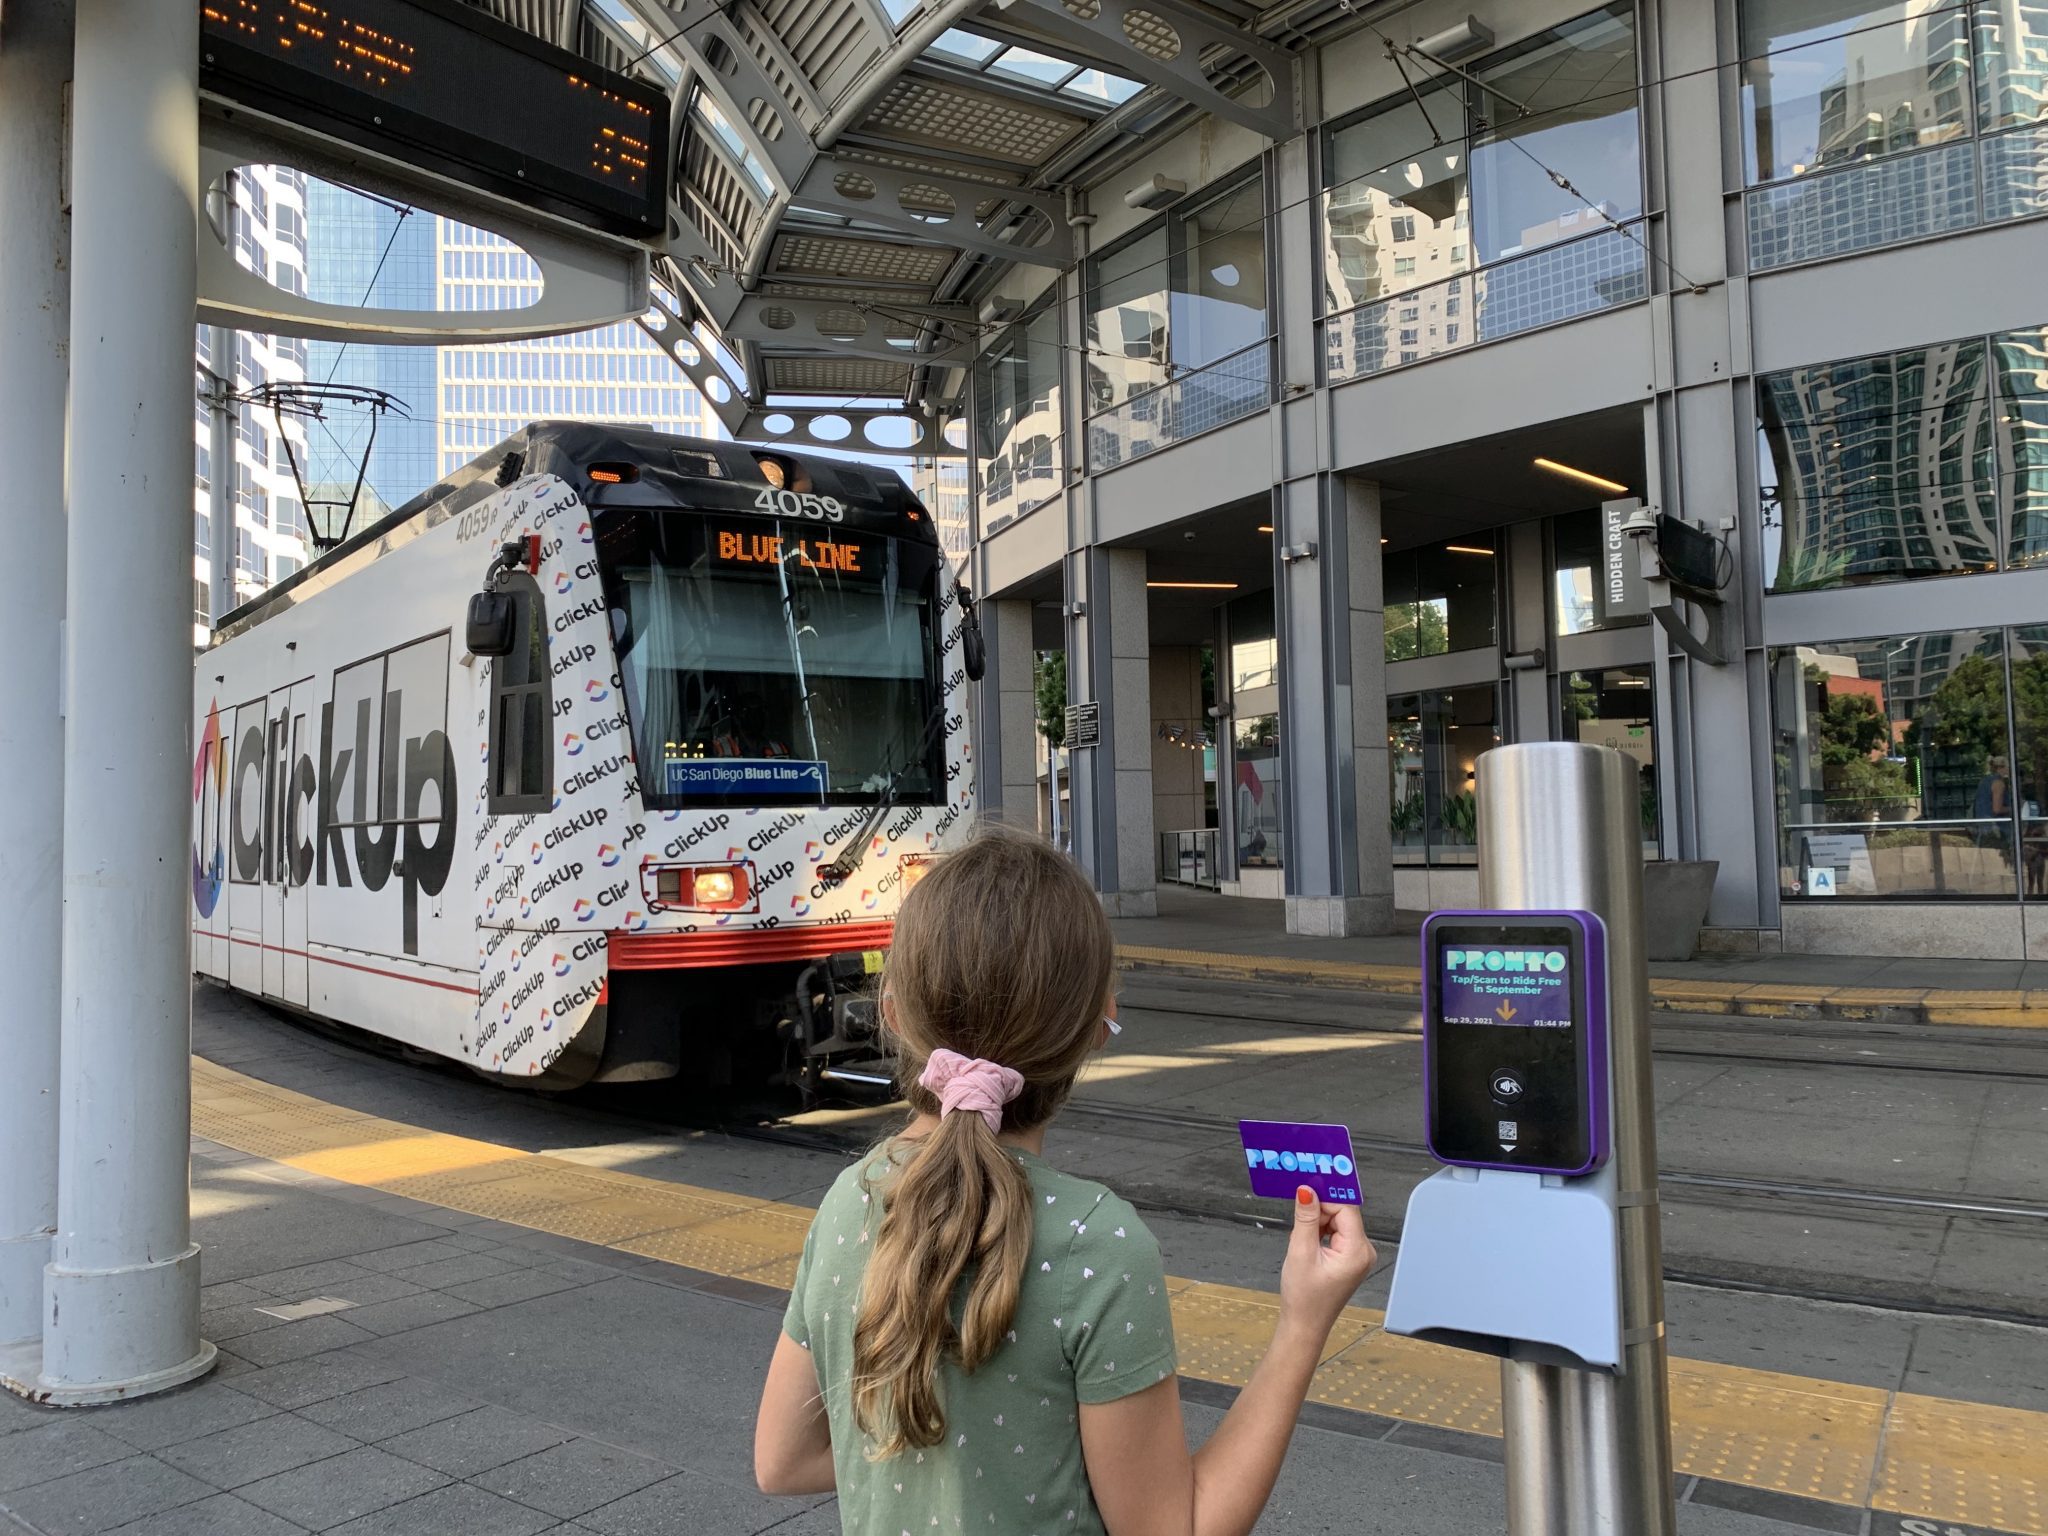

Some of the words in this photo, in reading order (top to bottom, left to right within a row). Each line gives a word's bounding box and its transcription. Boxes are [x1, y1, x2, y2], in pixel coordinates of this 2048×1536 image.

[534, 492, 585, 530] ClckU
[754, 490, 844, 523] 4059
[1608, 510, 1622, 550] CRAFT
[719, 531, 784, 564] BLUE
[799, 540, 861, 572] LINE
[1610, 552, 1624, 603] HIDDEN
[554, 597, 606, 633] ClickU
[943, 669, 965, 697] ckUp
[585, 711, 630, 741] Click
[671, 768, 689, 782] UC
[689, 768, 711, 781] San
[712, 767, 744, 783] Diego
[744, 767, 772, 780] Blue
[773, 767, 799, 780] Line
[233, 689, 458, 956] ClickUp
[504, 813, 536, 849] ClickUp
[544, 808, 608, 849] ClickUp
[664, 813, 730, 858] ClickUp
[823, 807, 870, 846] ClickUp
[887, 807, 923, 842] ClickUp
[935, 803, 959, 837] ClickU
[495, 864, 525, 904] ClickUp
[530, 862, 584, 904] ClickUp
[1815, 872, 1830, 887] A
[486, 917, 515, 956] ClickUp
[520, 917, 561, 957] ClickUp
[572, 935, 608, 961] Clic
[1446, 950, 1567, 973] PRONTO
[479, 969, 506, 1008] ClickUp
[511, 971, 545, 1010] ClickUp
[553, 975, 608, 1017] ClickU
[1451, 975, 1498, 985] Tap/Scan
[1499, 976, 1511, 985] to
[1512, 976, 1537, 986] Ride
[1538, 977, 1562, 986] Free
[1473, 984, 1484, 993] in
[1485, 985, 1542, 995] September
[1443, 1016, 1459, 1024] Sep
[1474, 1017, 1493, 1025] 2021
[1533, 1019, 1557, 1027] 01:44
[1558, 1020, 1572, 1028] PM
[502, 1025, 534, 1062] ClickUp
[1245, 1148, 1354, 1176] PRONTO
